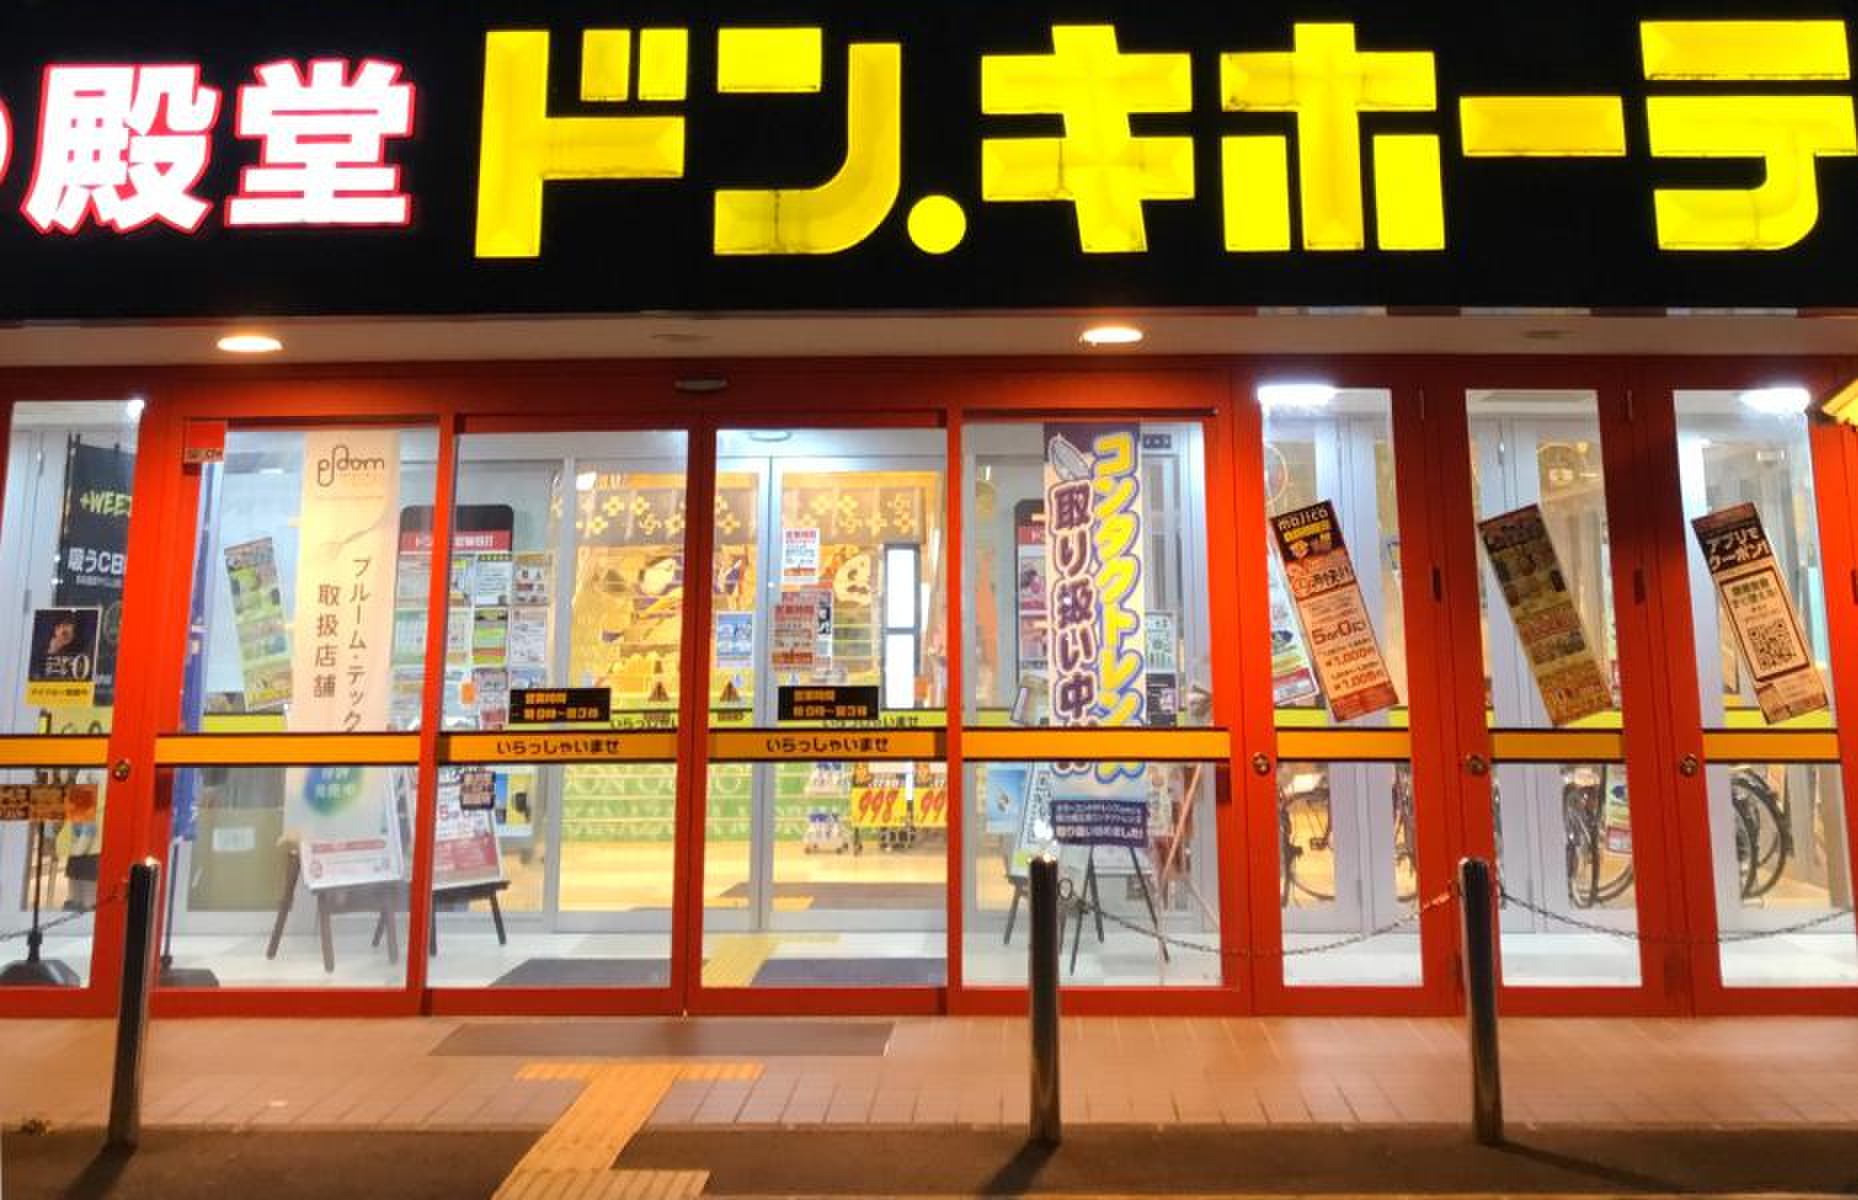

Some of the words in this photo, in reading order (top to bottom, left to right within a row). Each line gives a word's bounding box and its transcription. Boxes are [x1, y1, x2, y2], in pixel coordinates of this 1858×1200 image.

[0, 58, 414, 234] 殿堂
[67, 547, 126, 575] 吸うCB
[313, 583, 341, 699] 取扱店舗
[1093, 431, 1140, 780] コンタクトレン
[497, 739, 619, 755] いらっしゃいませ
[766, 737, 889, 753] いらっしゃいませ
